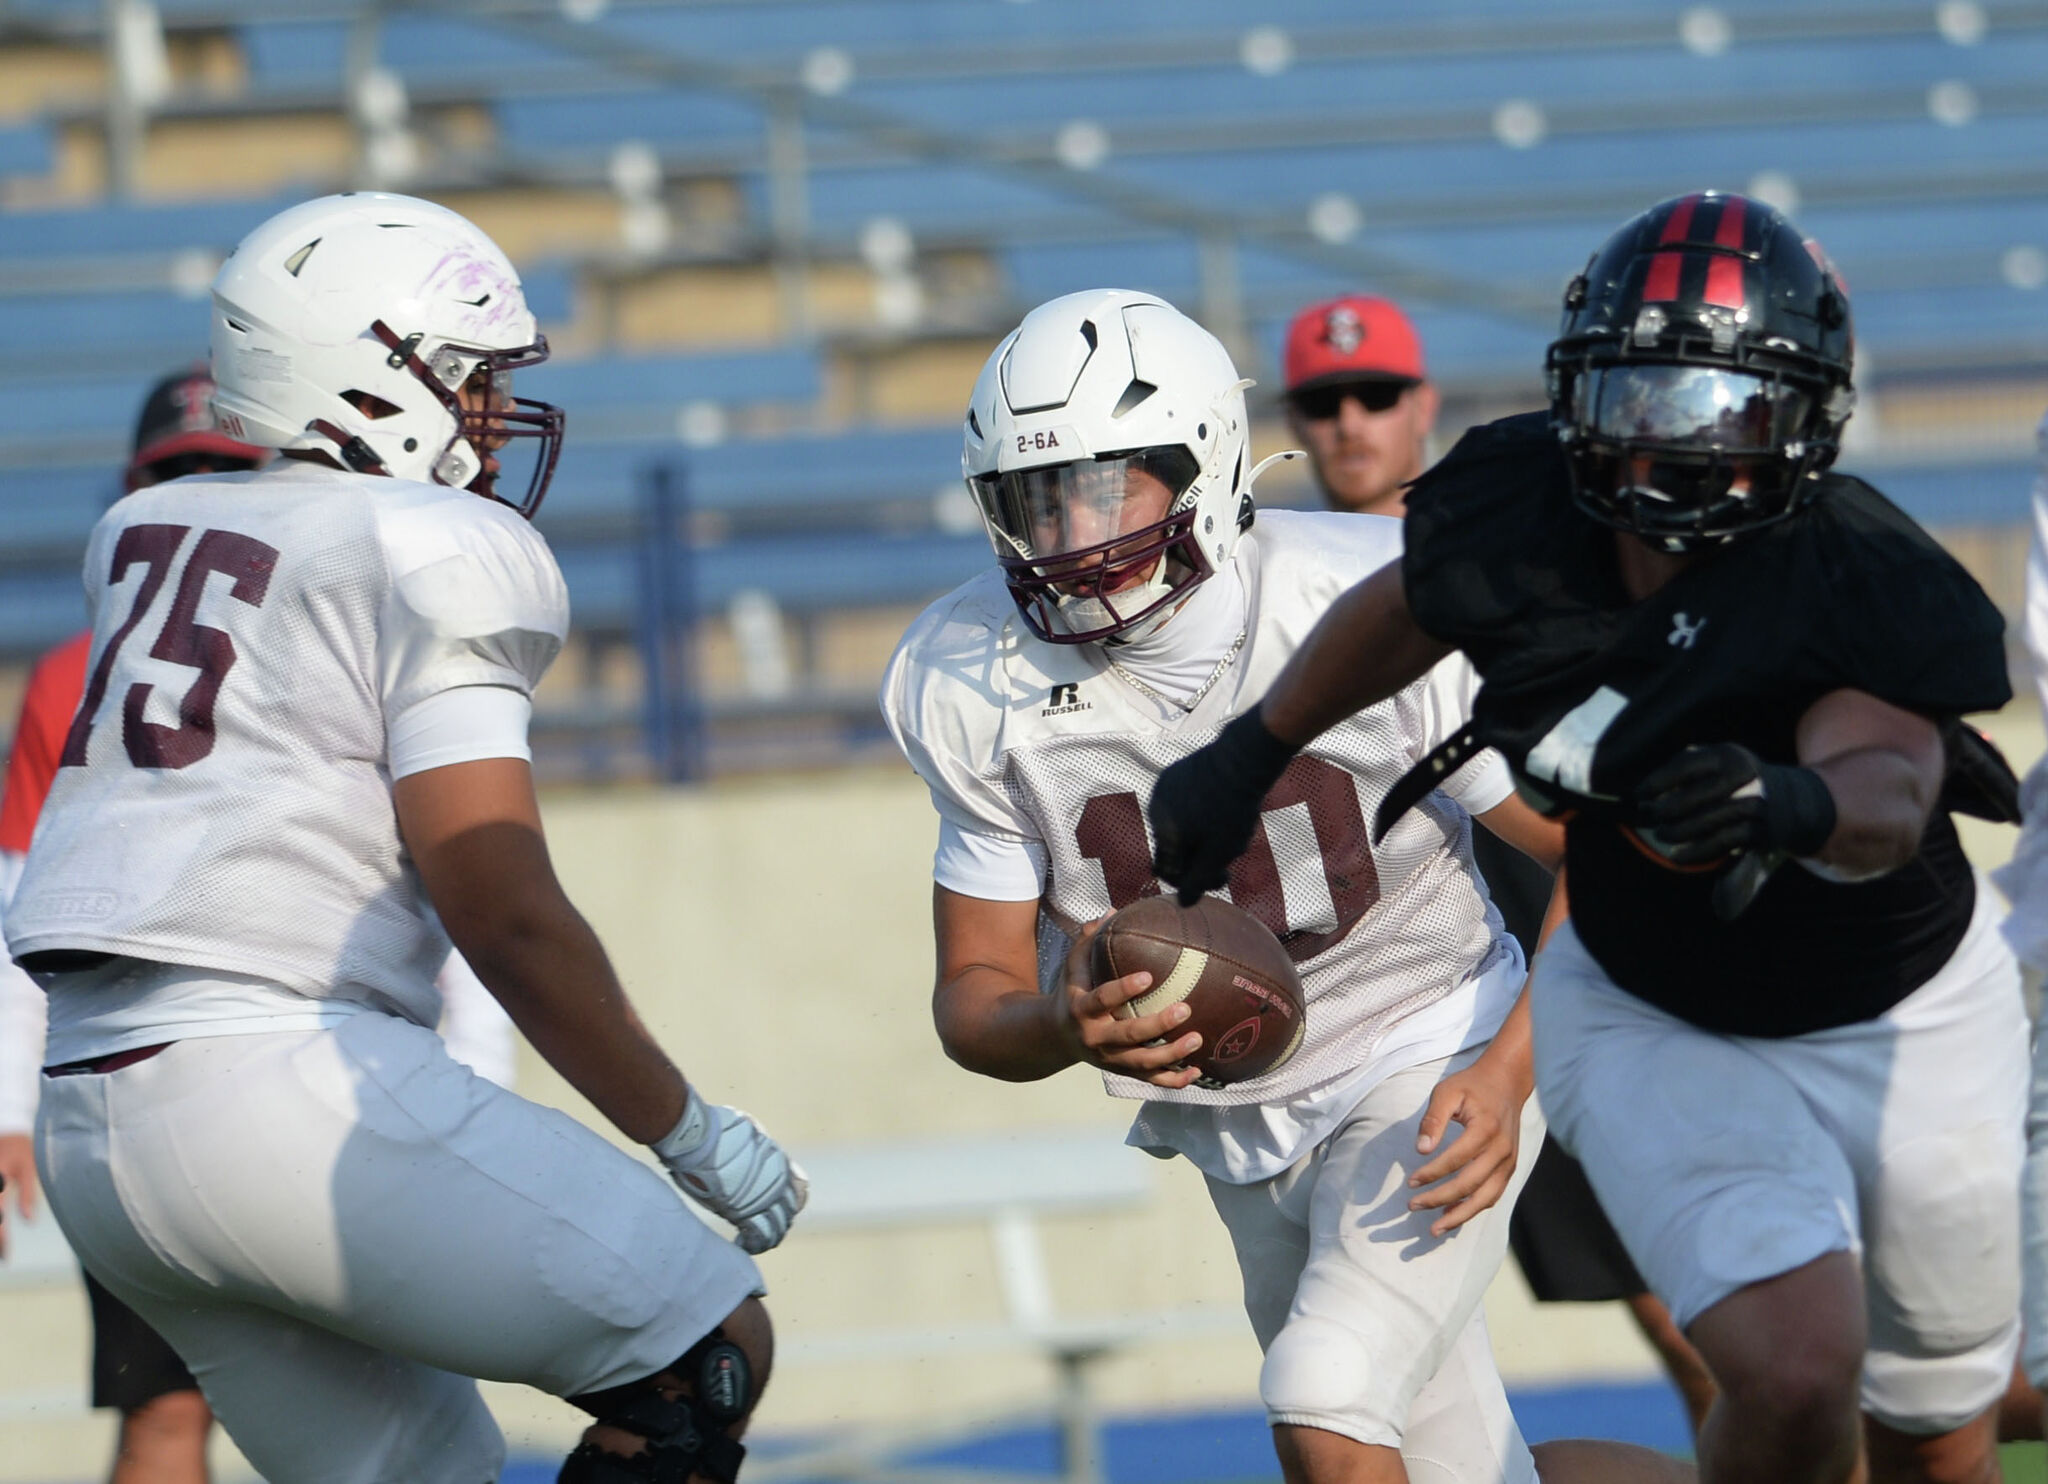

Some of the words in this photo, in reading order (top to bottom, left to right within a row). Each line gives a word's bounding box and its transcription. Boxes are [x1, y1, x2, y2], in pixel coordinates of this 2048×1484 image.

[1016, 430, 1060, 453] 2-6A
[59, 523, 280, 769] 75
[1048, 682, 1079, 708] R
[1041, 701, 1093, 718] RUSSELL
[1075, 753, 1380, 962] 10
[1231, 975, 1271, 999] ISSUE
